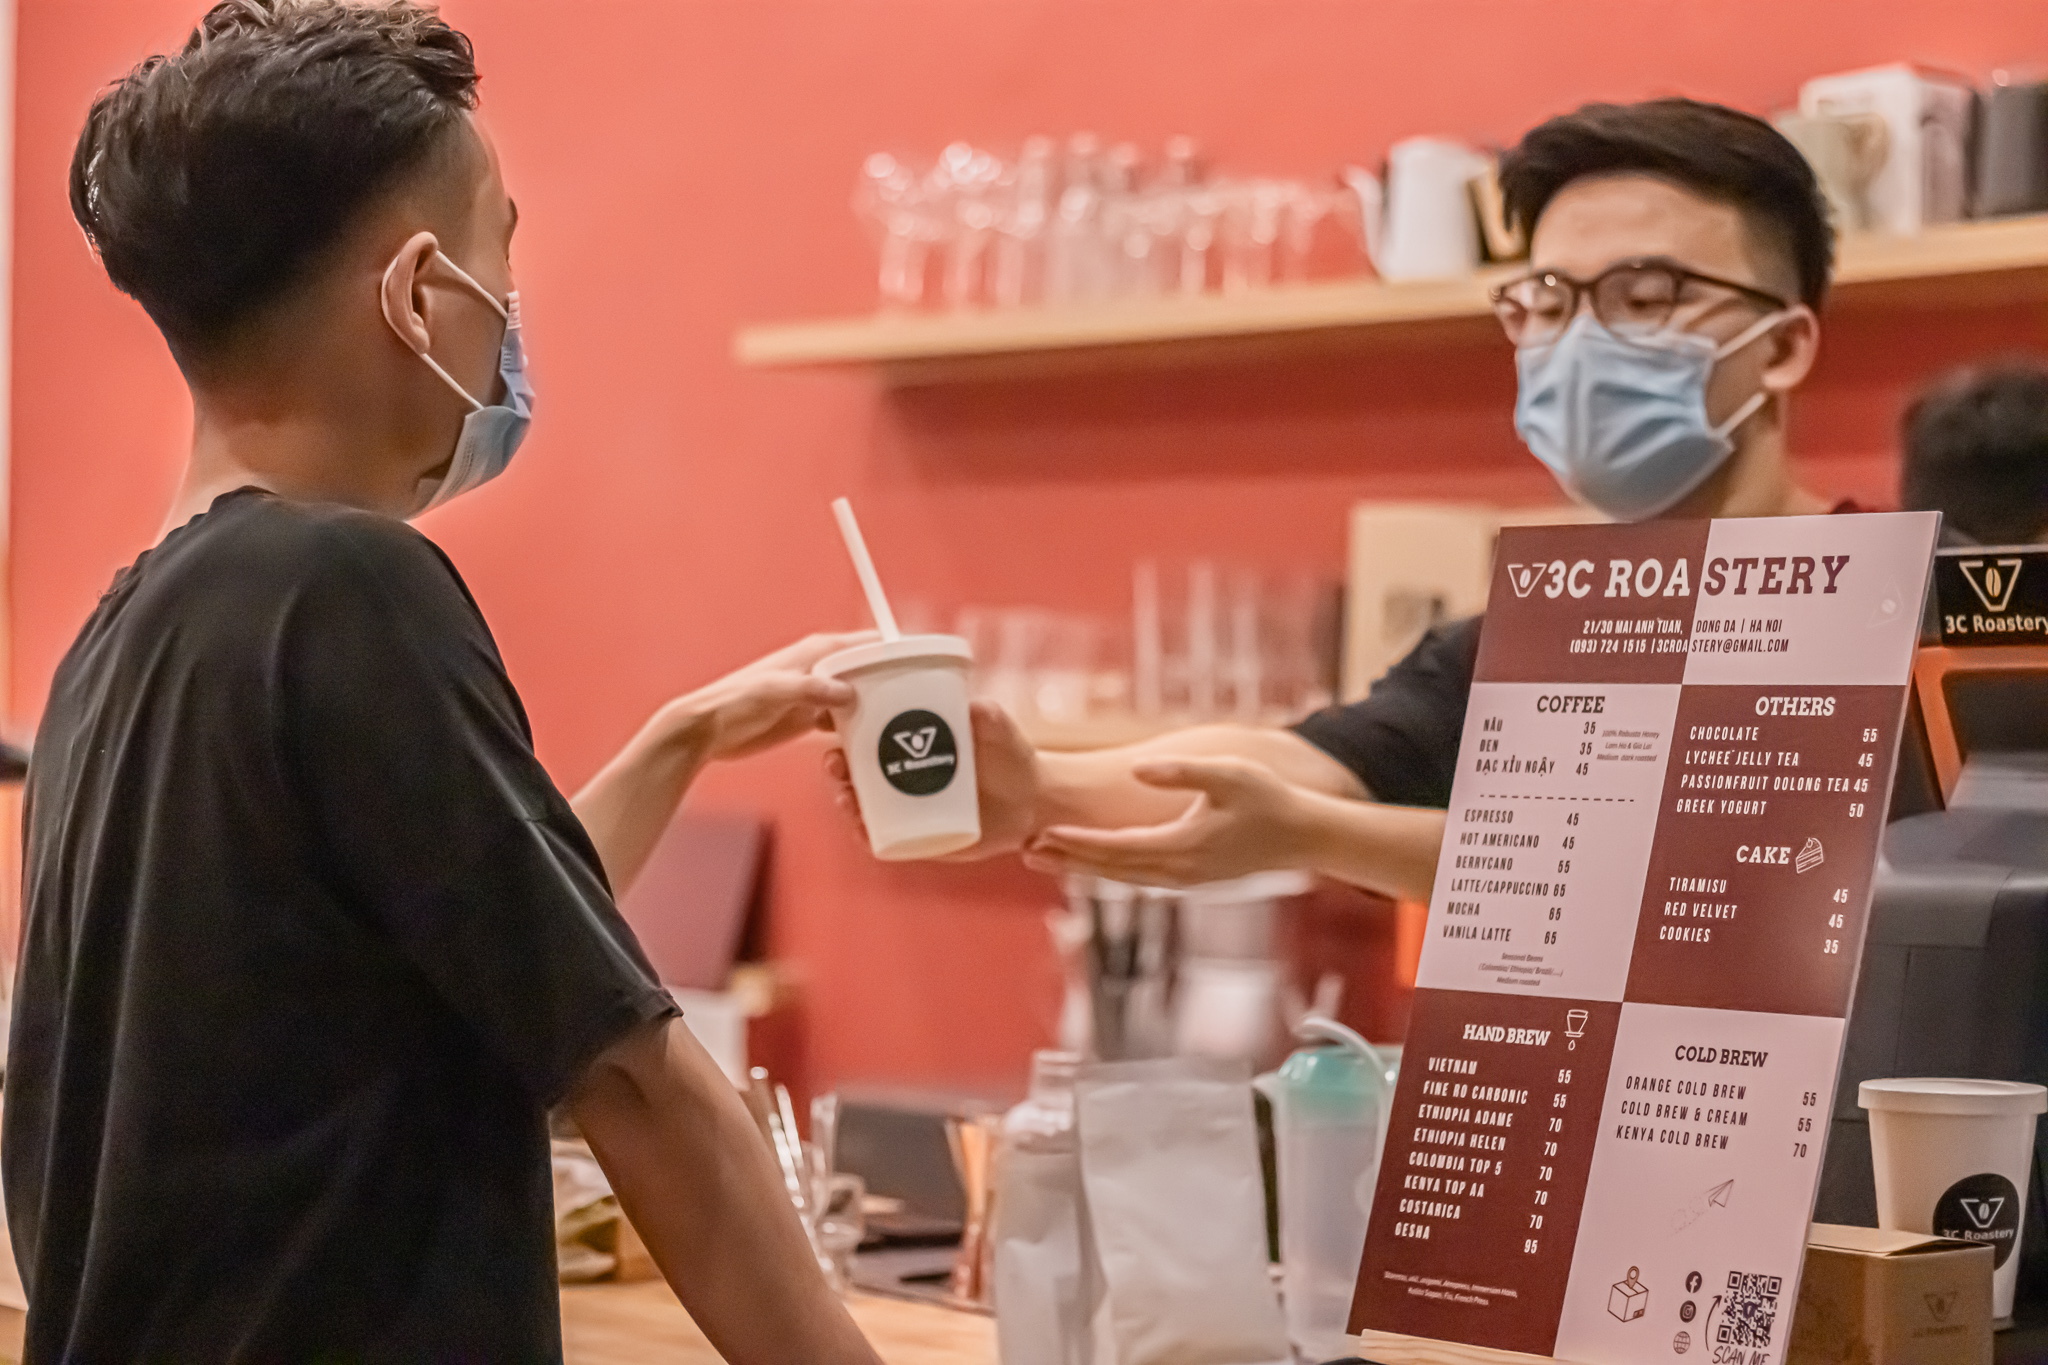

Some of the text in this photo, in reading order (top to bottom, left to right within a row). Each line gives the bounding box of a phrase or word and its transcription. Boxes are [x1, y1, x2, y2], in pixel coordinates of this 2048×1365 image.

[1544, 559, 1595, 599] 3C
[1583, 620, 1613, 634] 21/30
[1615, 620, 1633, 634] MAI
[1634, 620, 1655, 634] ANH
[1696, 619, 1721, 633] DONG
[1724, 619, 1736, 633] DA
[1749, 619, 1762, 633] HA
[1765, 619, 1783, 633] NOI
[1945, 614, 1968, 634] 3C
[1570, 638, 1598, 654] (093)
[1600, 639, 1619, 654] 724
[1622, 639, 1646, 654] 1515
[1536, 695, 1606, 714] COFFEE
[1755, 696, 1836, 717] OTHERS
[1583, 721, 1596, 735] 35
[1690, 726, 1878, 743] CHOCOLATE 55
[1579, 742, 1593, 756] 35
[1575, 762, 1589, 776] 45
[1735, 751, 1771, 766] JELLY
[1777, 752, 1799, 767] TEA
[1858, 753, 1873, 768] 45
[1681, 774, 1869, 793] PASSIONFRUIT OOLONG TEA 45
[1464, 809, 1580, 826] ESPRESSO 45
[1676, 799, 1865, 818] GREEK YOGURT 50
[1460, 832, 1575, 850] HOT AMERICANO 45
[1455, 855, 1571, 874] BERRYCANO 55
[1736, 845, 1791, 865] CAKE
[1451, 878, 1566, 897] LATTE/CAPPUCCINO 65
[1669, 877, 1848, 904] TIRAMISU 45
[1446, 901, 1562, 921] MOCHA 65
[1664, 902, 1844, 929] RED VELVET 45
[1442, 925, 1557, 945] VANILA LATTE 65
[1659, 926, 1839, 954] COOKIES 35
[1463, 1024, 1551, 1047] HAND BREW
[1675, 1045, 1768, 1068] COLD BREW
[1428, 1057, 1572, 1084] VIETNAM 55
[1422, 1080, 1449, 1097] FINE
[1471, 1086, 1529, 1105] CARBONIC
[1553, 1094, 1567, 1109] 55
[1626, 1075, 1817, 1107] ORANGE COLD BREW 55
[1418, 1104, 1562, 1133] ETHIOPIA ADAME 70
[1621, 1100, 1812, 1133] COLD BREW & CREAM 55
[1413, 1127, 1558, 1157] ETHIOPIA HELEN 70
[1616, 1125, 1808, 1158] KENYA COLD BREW 70
[1408, 1151, 1553, 1182] COLOMBIA TOP 5 70
[1404, 1175, 1548, 1206] KENYA TOP AA 70
[1399, 1198, 1543, 1230] COSTARICA 70
[1964, 1228, 2015, 1241] Roastery
[1524, 1239, 1539, 1254] 95
[1712, 1345, 1747, 1365] SCAN
